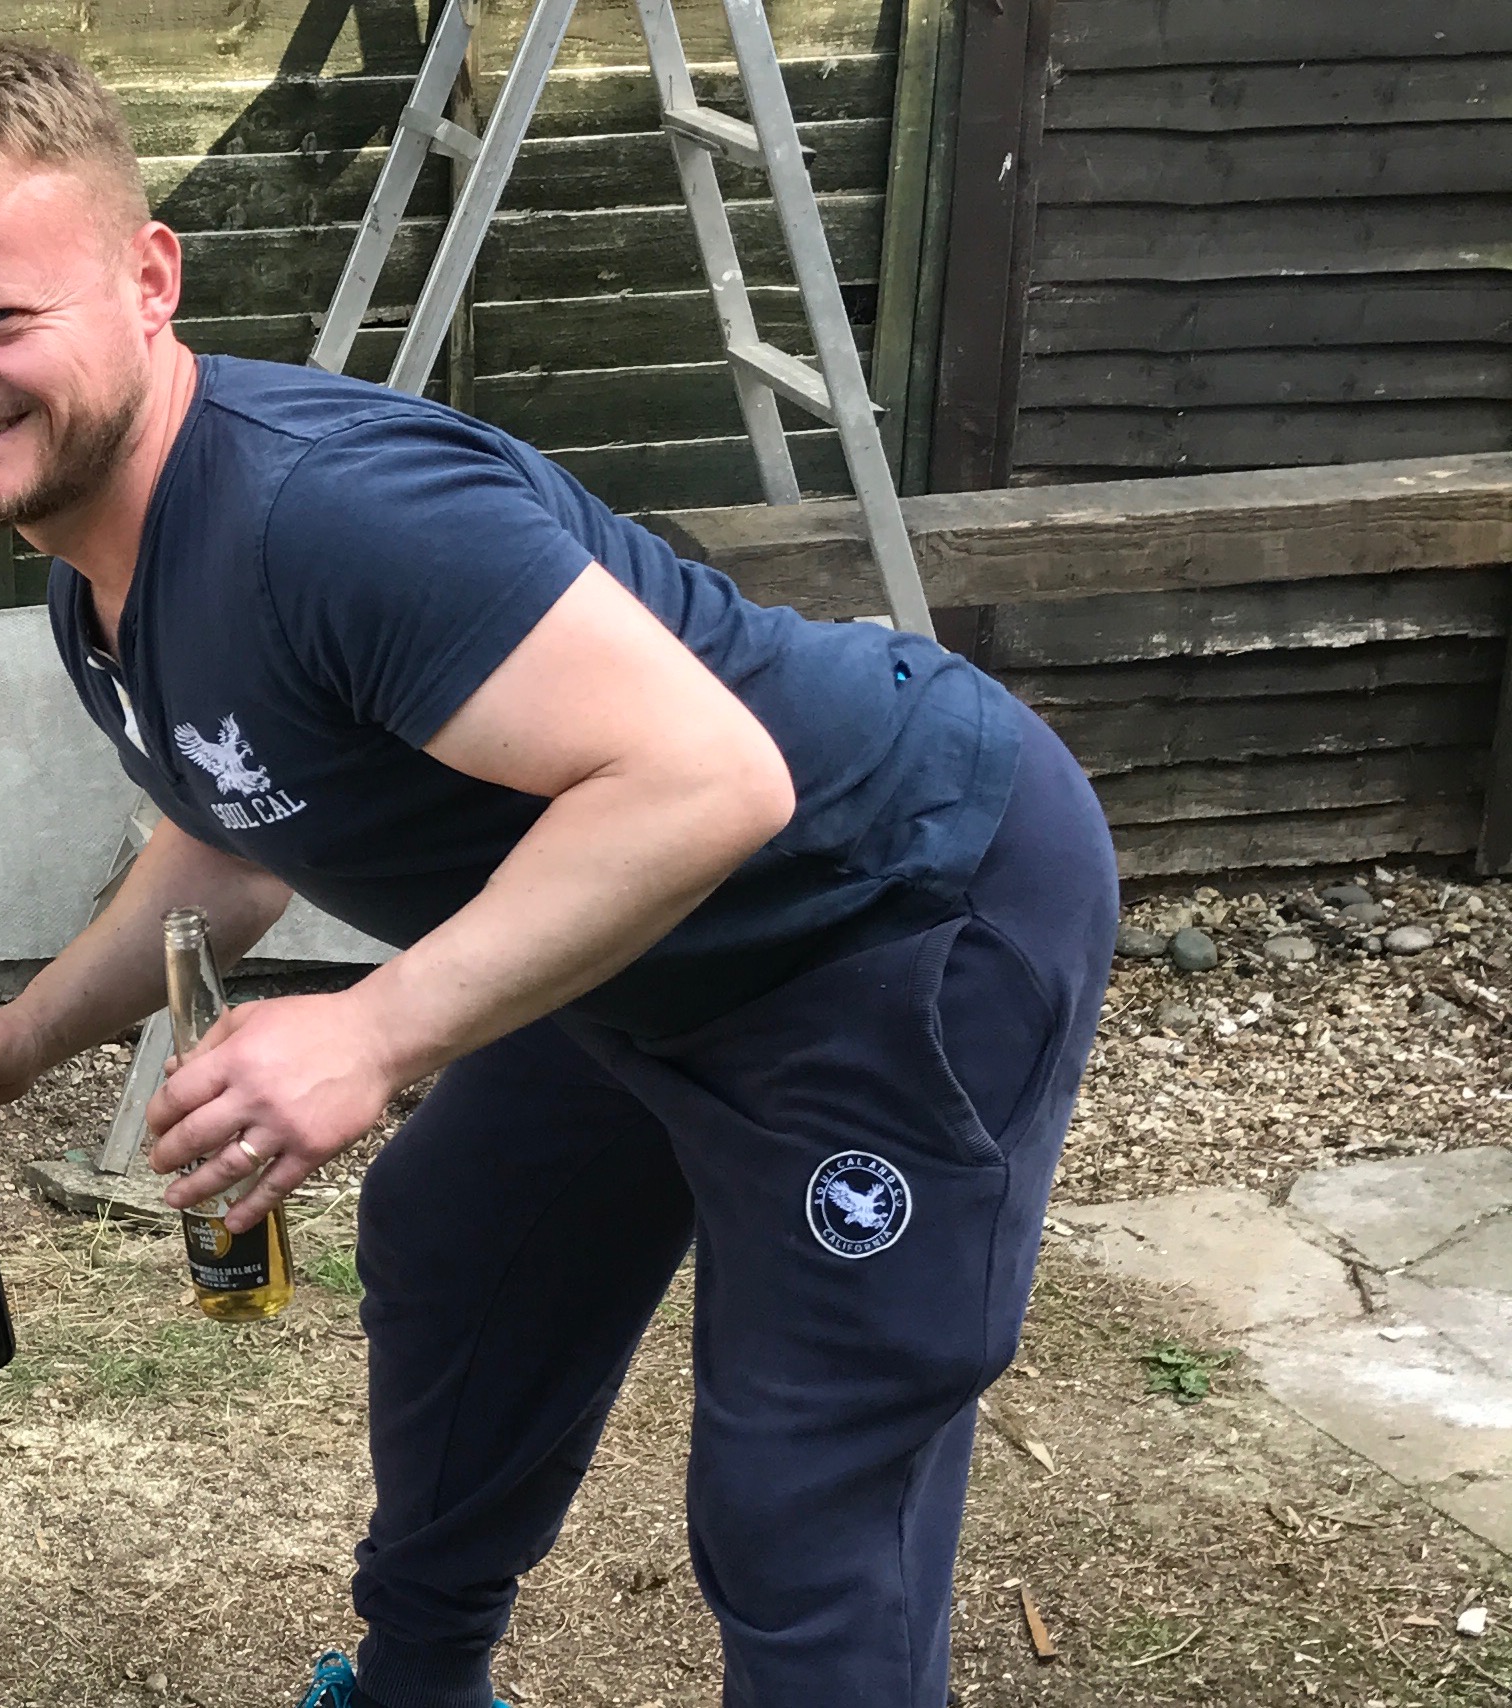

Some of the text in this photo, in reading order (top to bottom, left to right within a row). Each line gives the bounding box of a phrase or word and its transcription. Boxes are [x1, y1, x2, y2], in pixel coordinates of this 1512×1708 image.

[210, 789, 307, 829] SOUL CAL
[814, 1168, 835, 1205] SOUL
[836, 1157, 863, 1170] CAL
[868, 1160, 896, 1184] AND
[822, 1228, 892, 1253] CALIFORNIA
